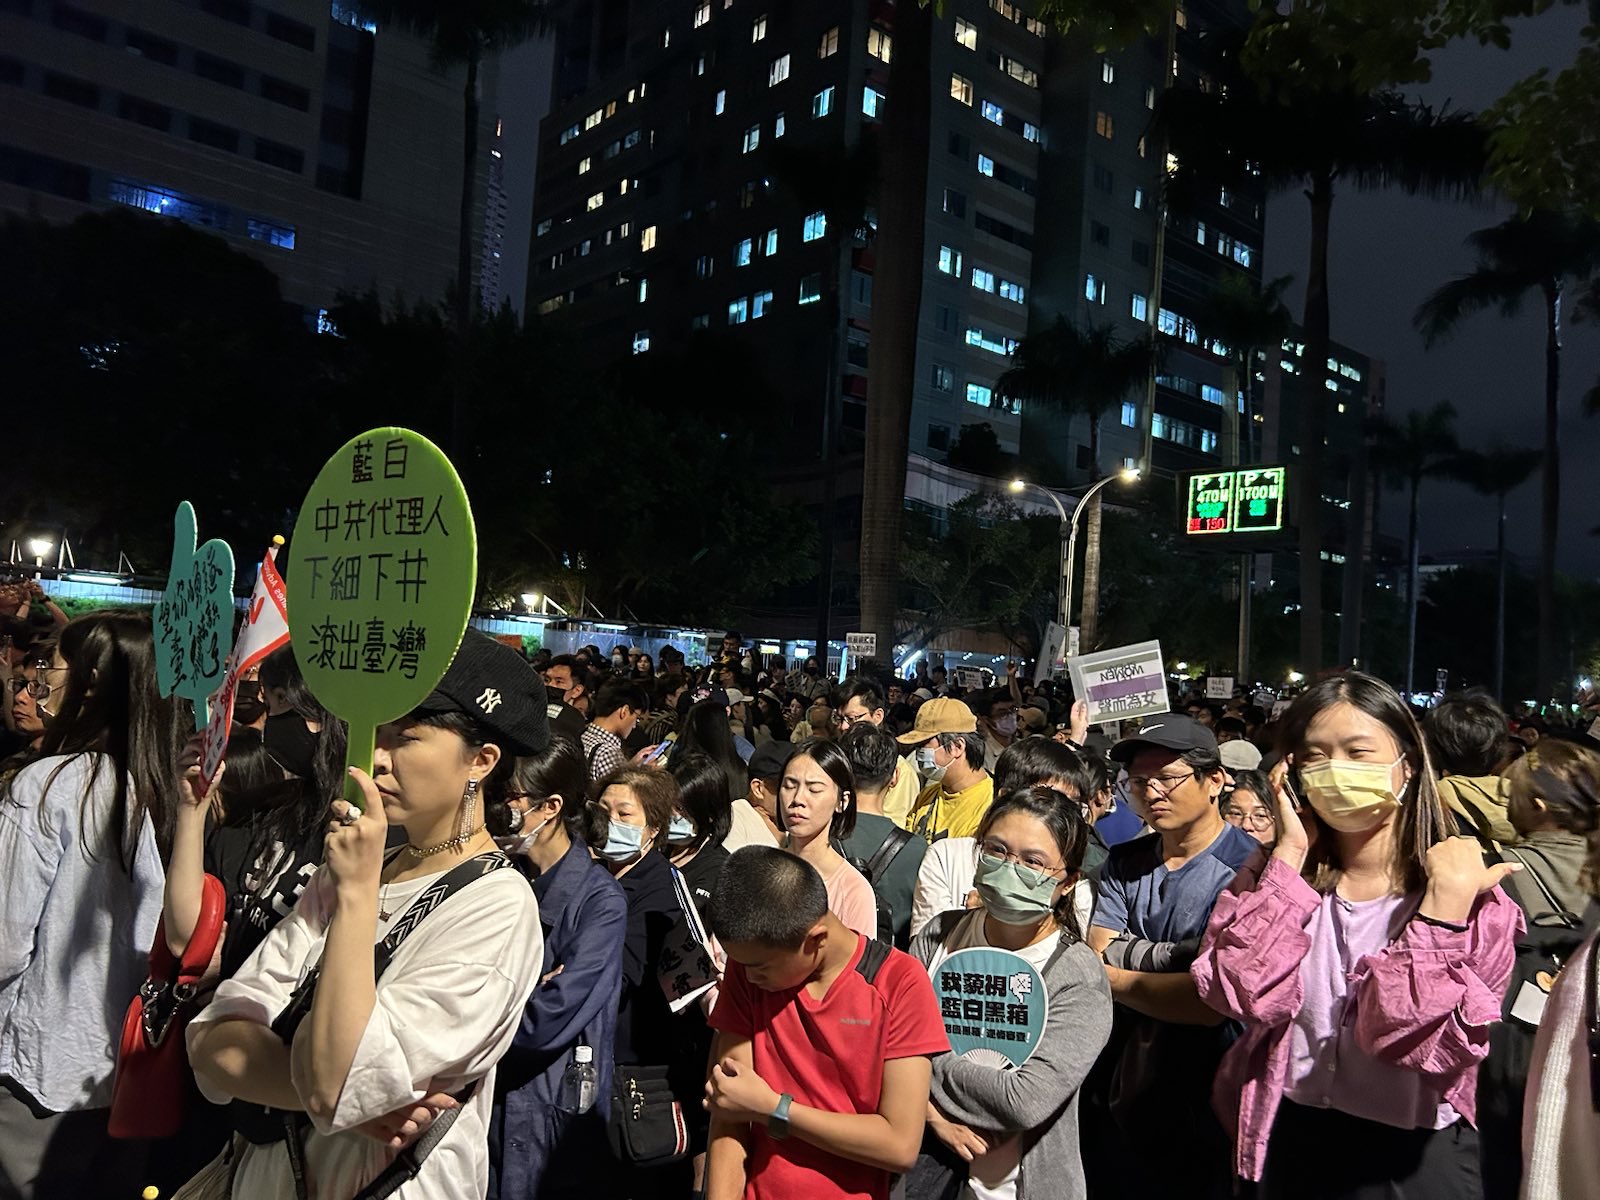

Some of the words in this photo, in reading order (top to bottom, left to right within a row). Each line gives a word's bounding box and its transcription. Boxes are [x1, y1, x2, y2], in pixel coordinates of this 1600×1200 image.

[352, 438, 408, 484] 藍白
[315, 495, 449, 543] 中共代理人
[304, 549, 428, 603] 下細下井
[307, 615, 427, 680] 滾出臺灣
[941, 971, 1007, 997] 我藐視
[941, 996, 1028, 1026] 藍白黑箱
